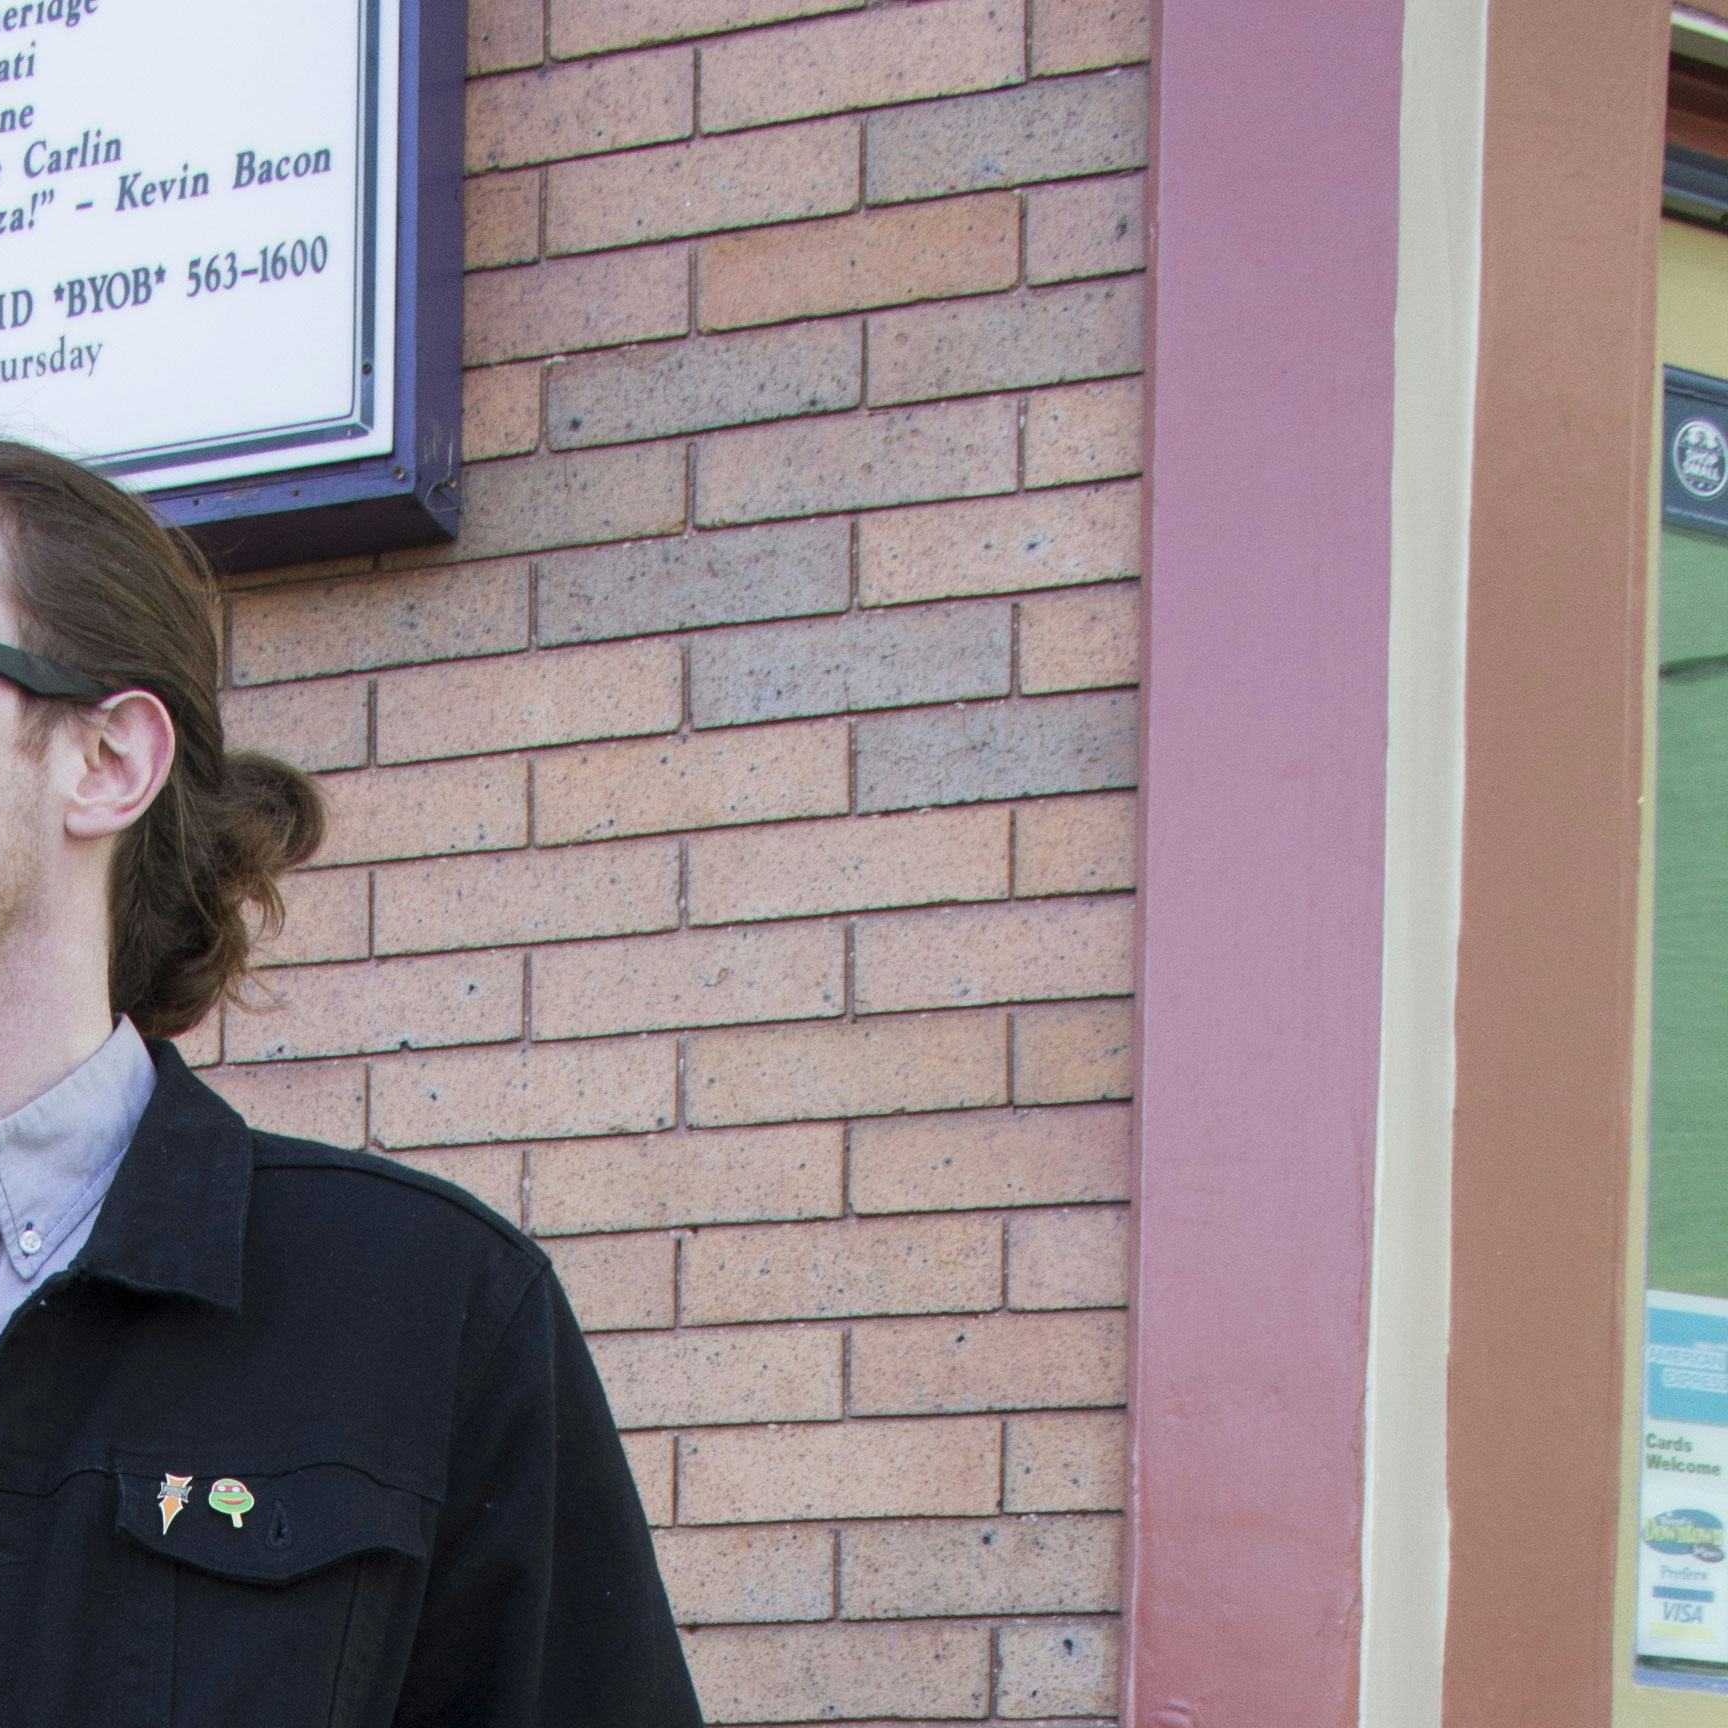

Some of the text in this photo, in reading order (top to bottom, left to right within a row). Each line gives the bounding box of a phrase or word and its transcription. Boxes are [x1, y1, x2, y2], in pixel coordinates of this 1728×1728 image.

[23, 128, 122, 179] Carlin
[114, 162, 210, 212] Kevin
[231, 147, 332, 190] Bacon
[1646, 1432, 1692, 1453] Cards
[1646, 1453, 1721, 1477] Welcome
[1663, 1602, 1703, 1624] VISA
